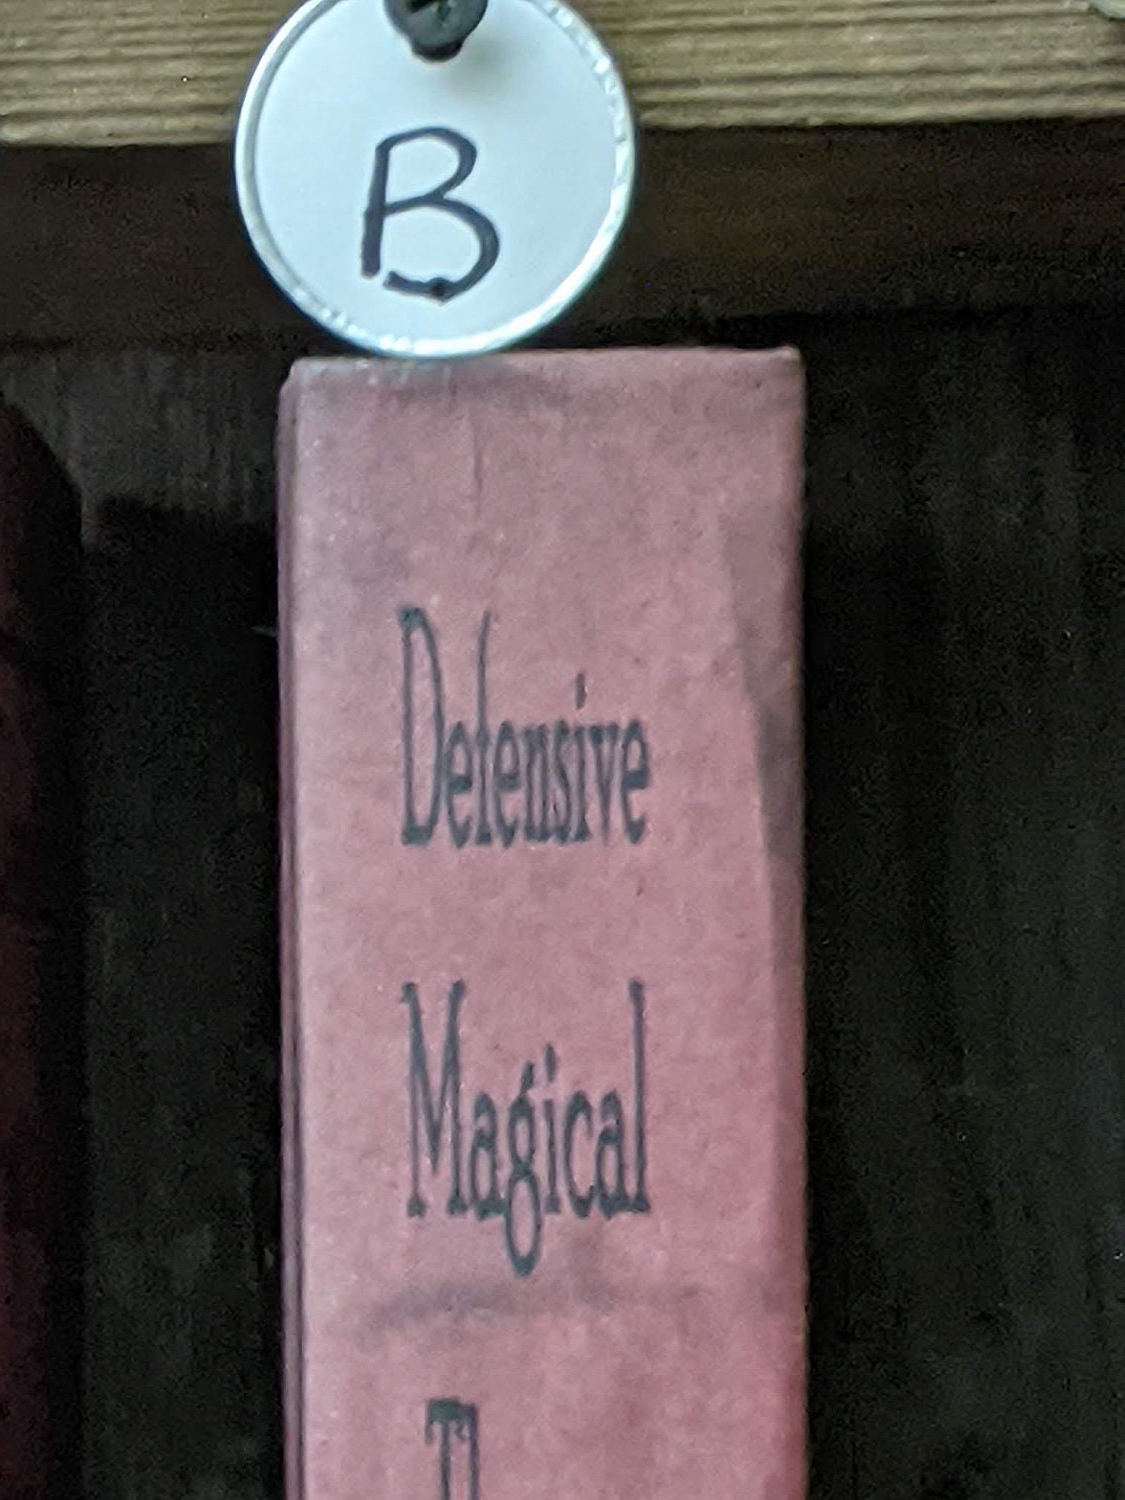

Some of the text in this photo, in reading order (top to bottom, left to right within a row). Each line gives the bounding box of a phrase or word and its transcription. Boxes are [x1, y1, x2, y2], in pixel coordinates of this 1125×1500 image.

[361, 126, 501, 304] B
[397, 606, 651, 848] Defensive
[401, 979, 651, 1279] Magical
